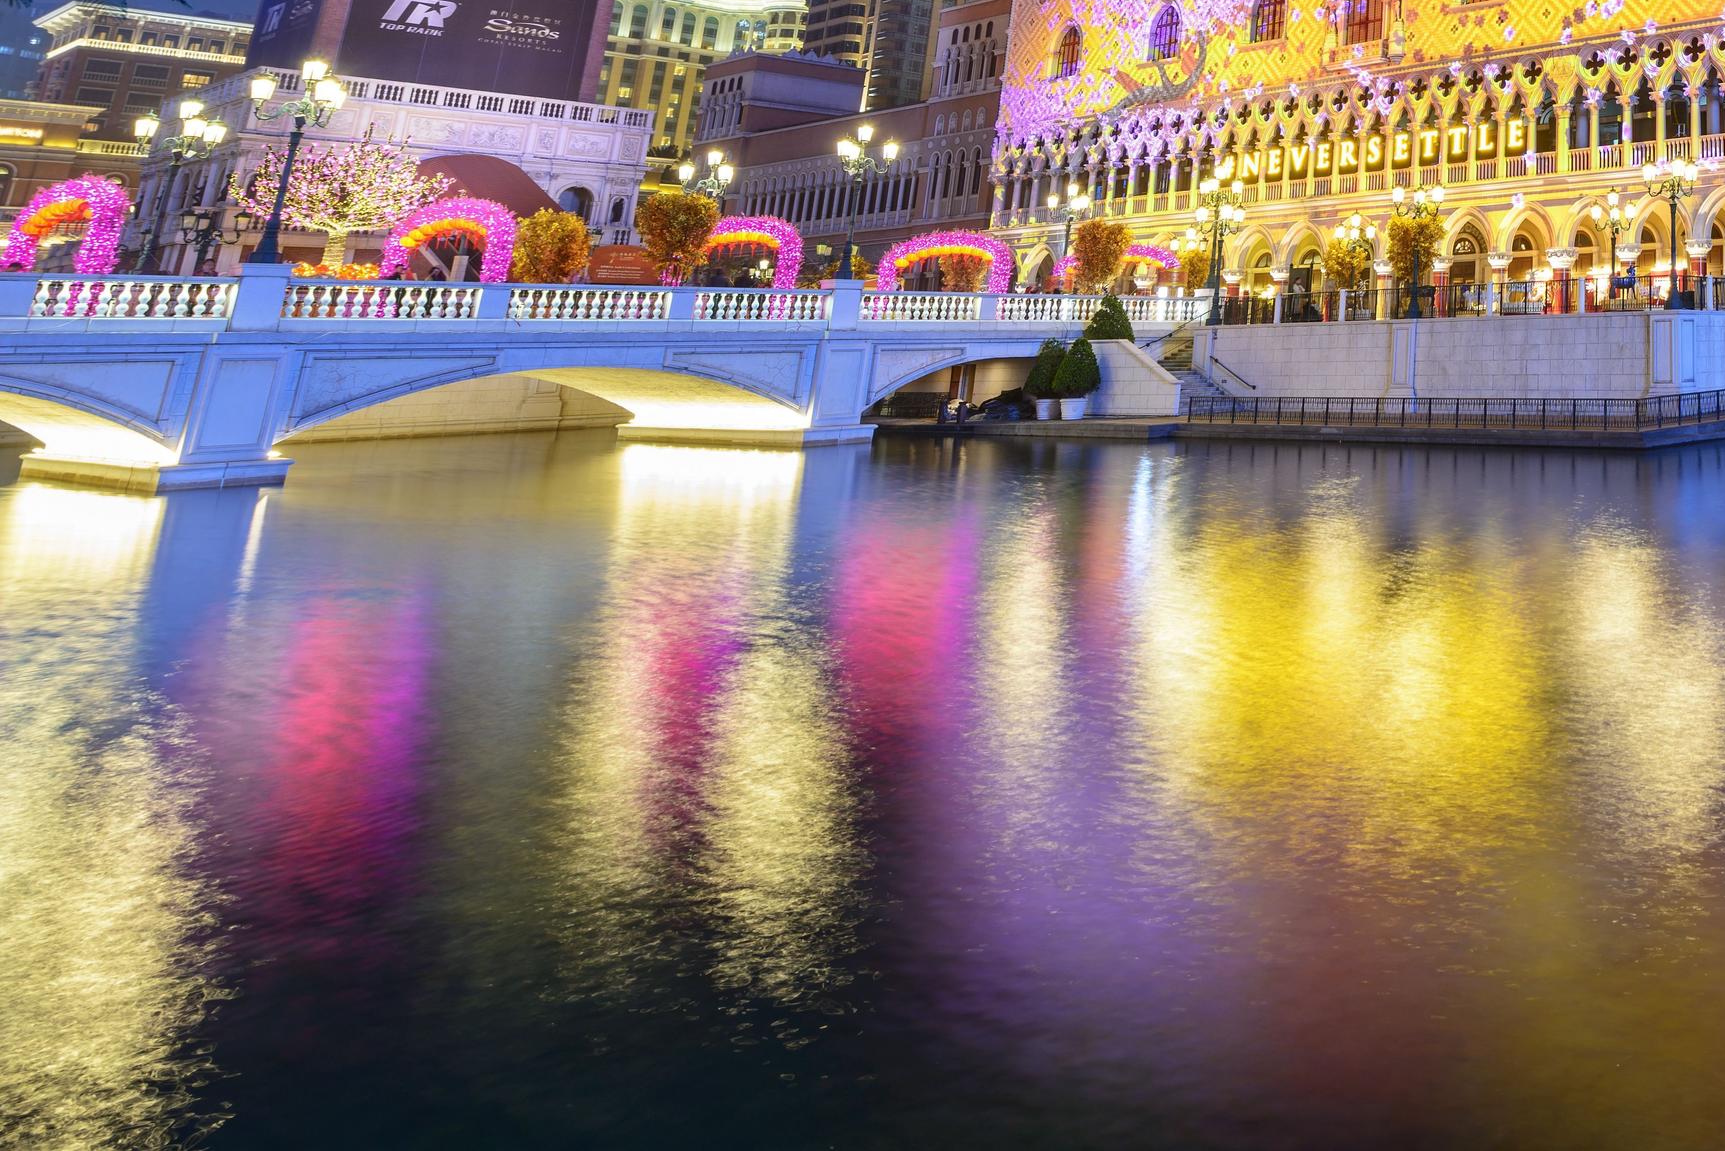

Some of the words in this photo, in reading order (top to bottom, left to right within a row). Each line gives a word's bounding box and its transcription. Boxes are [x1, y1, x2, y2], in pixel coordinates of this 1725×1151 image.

[379, 22, 406, 32] TOP
[406, 26, 445, 37] RANK
[482, 18, 561, 40] Sands
